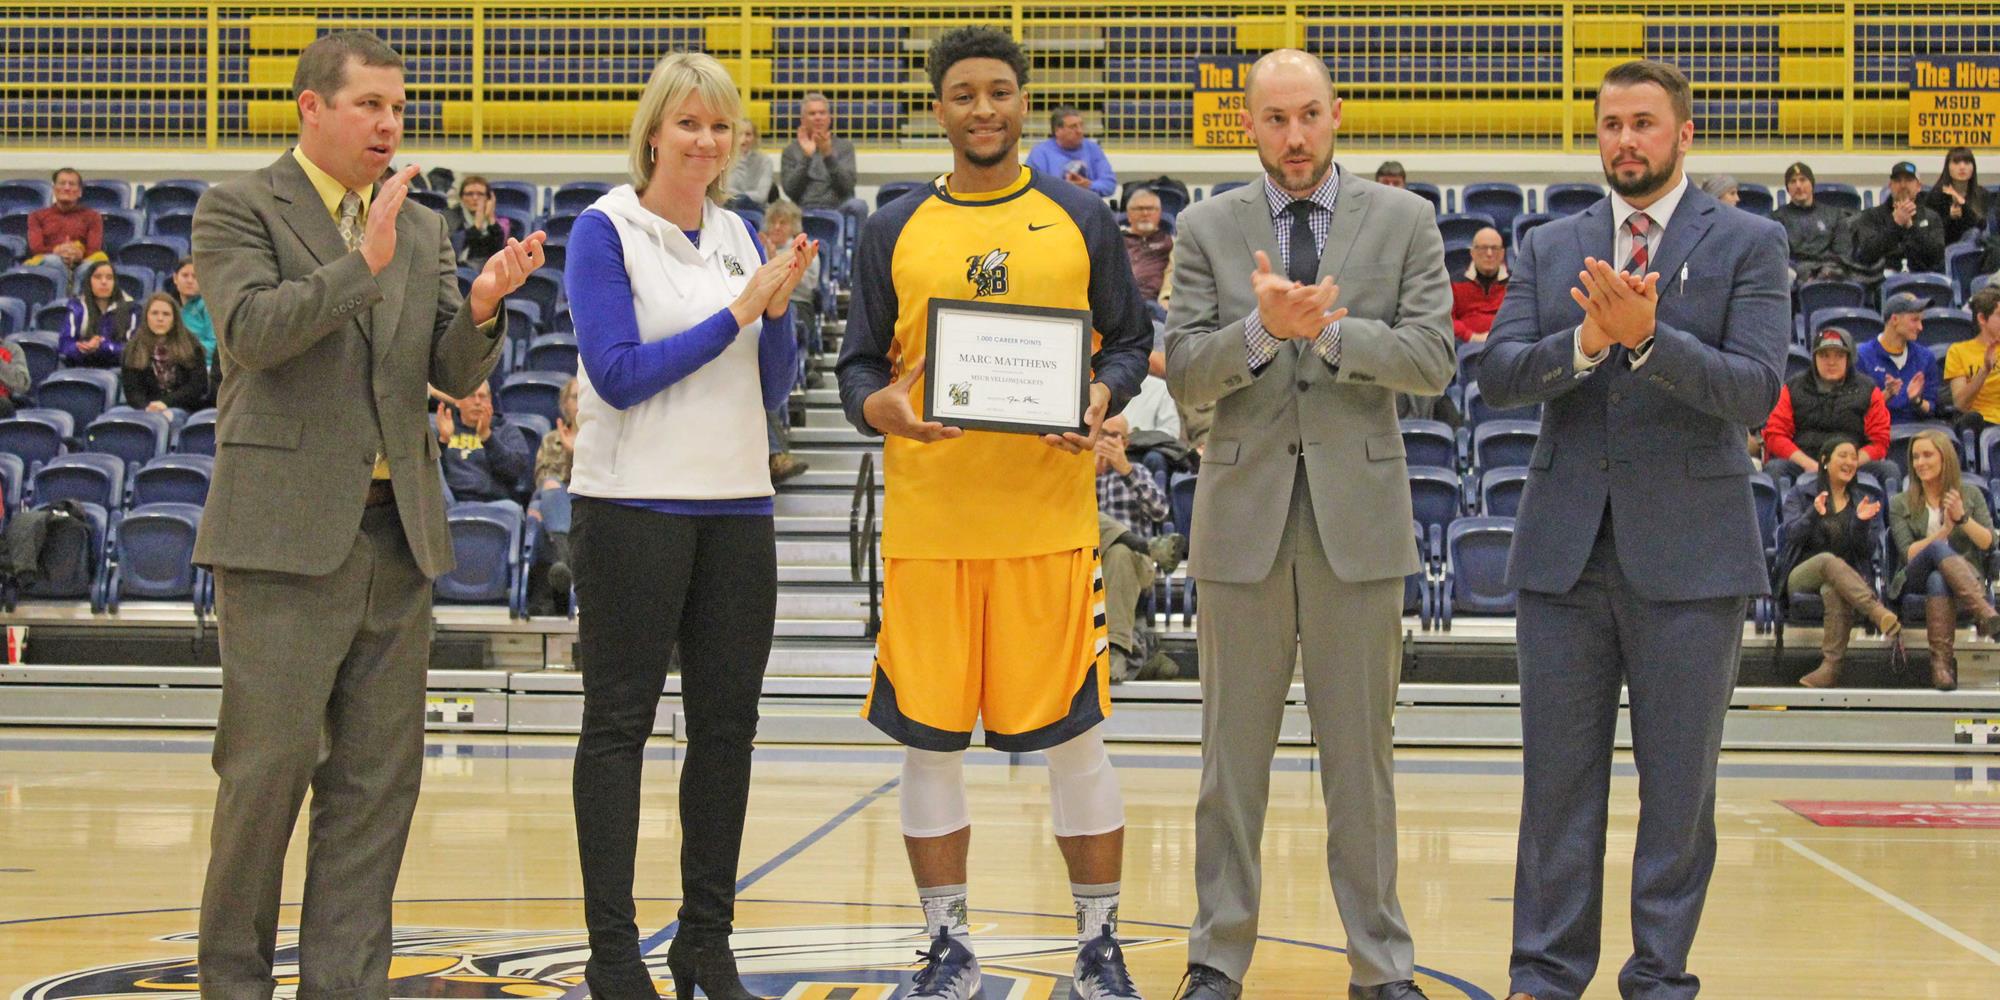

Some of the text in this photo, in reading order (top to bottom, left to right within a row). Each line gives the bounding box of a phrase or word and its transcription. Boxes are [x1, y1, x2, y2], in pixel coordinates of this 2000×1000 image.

[1199, 63, 1233, 88] The
[1914, 62, 2000, 88] The Hive
[1218, 96, 1248, 110] MSU
[1934, 95, 1981, 110] MSUB
[1202, 113, 1242, 127] STUD
[1918, 113, 1996, 127] STUDENT
[1922, 130, 1992, 144] SECTION
[994, 336, 1019, 344] CAREER
[959, 353, 1057, 370] MARC MATTHEWS
